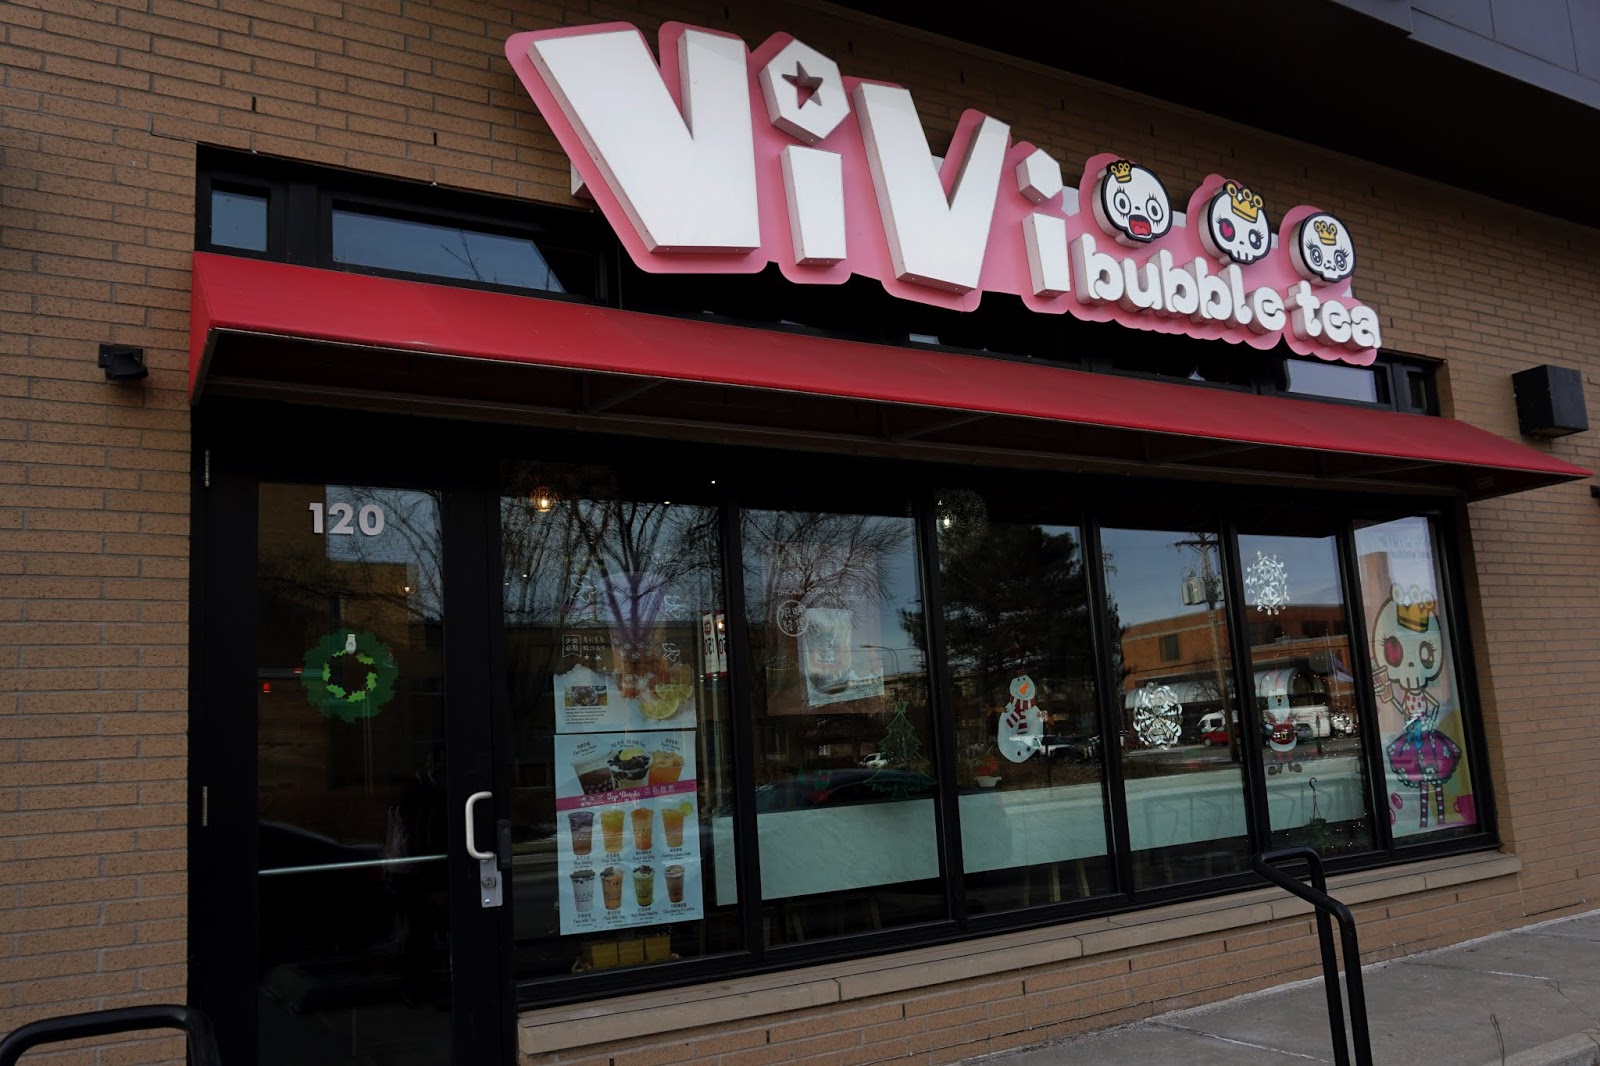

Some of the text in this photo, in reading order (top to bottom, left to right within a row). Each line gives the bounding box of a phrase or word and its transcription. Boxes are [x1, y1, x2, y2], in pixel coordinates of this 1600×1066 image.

[527, 29, 1071, 297] ViVi
[1073, 233, 1382, 349] bubble tea
[308, 502, 385, 536] 120
[619, 788, 641, 798] Drinks
